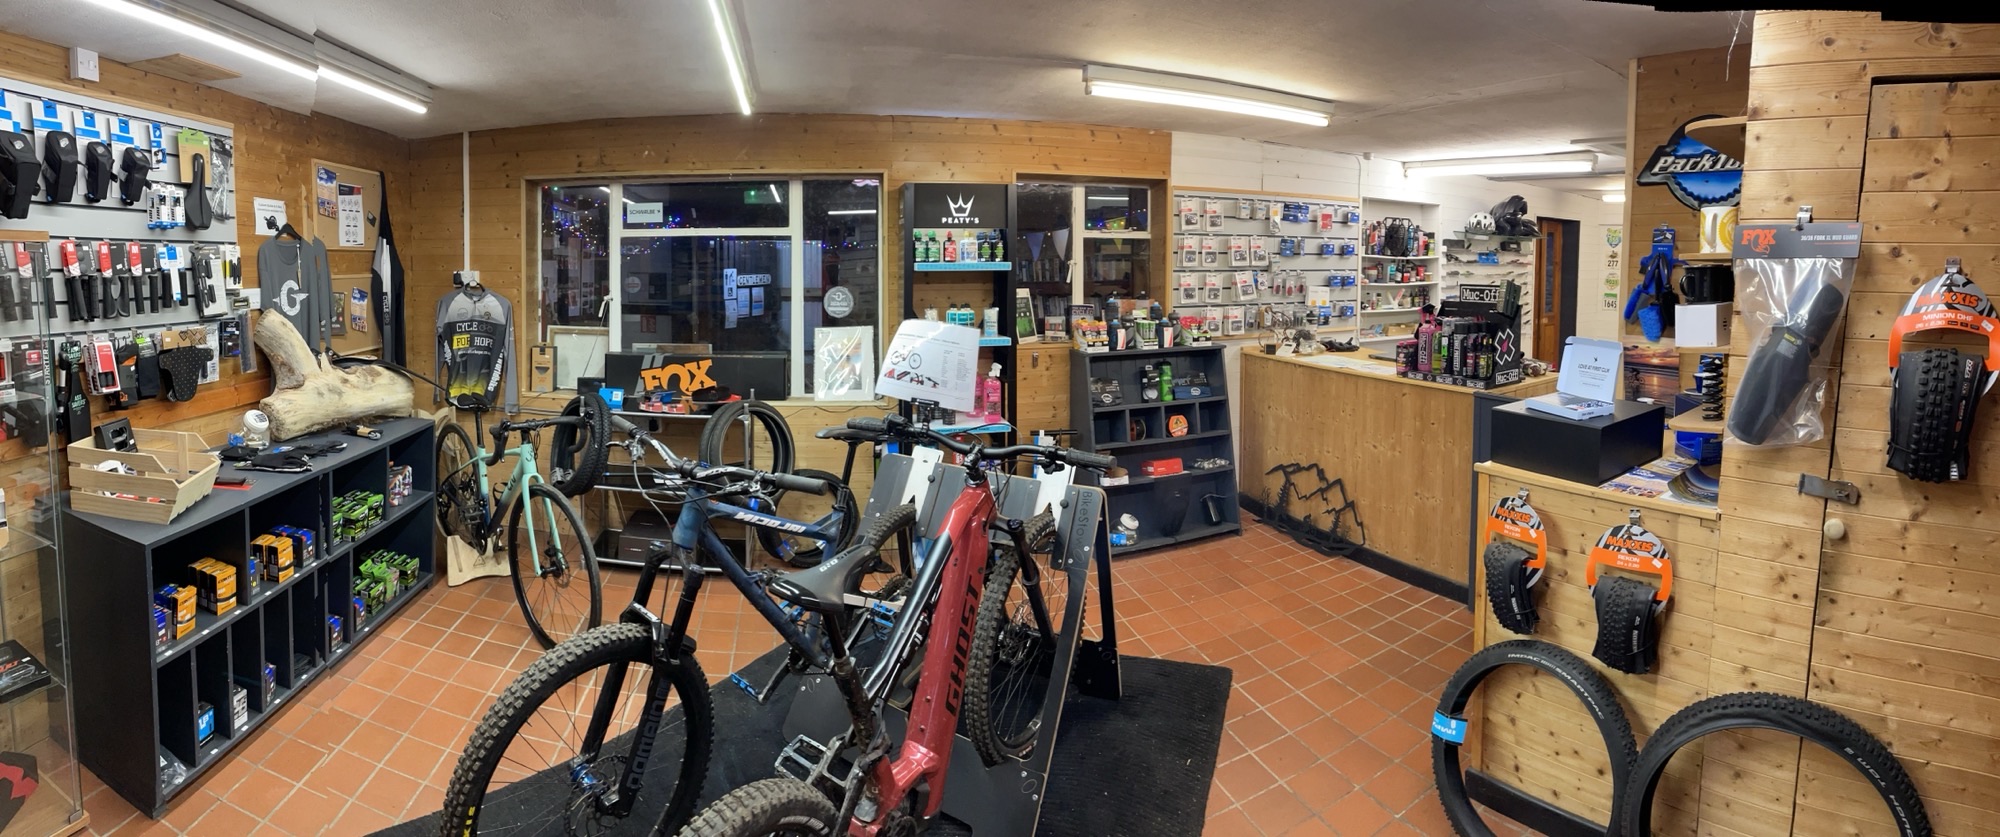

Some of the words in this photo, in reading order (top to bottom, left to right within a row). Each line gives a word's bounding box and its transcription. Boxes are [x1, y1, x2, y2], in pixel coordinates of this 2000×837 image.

[1741, 229, 1777, 247] FOX
[1462, 289, 1499, 301] Muc-Off
[1916, 292, 1979, 308] MAXXIS
[1922, 312, 1955, 320] MINION
[456, 321, 478, 332] CYCLE
[641, 359, 717, 396] FOX
[1497, 372, 1518, 384] Muc-Off
[1496, 507, 1532, 523] MAXXIS
[1606, 536, 1654, 552] MAXXIS
[1617, 554, 1640, 563] REKON
[945, 574, 979, 716] GHOST
[1555, 668, 1605, 720] SMARTPAC
